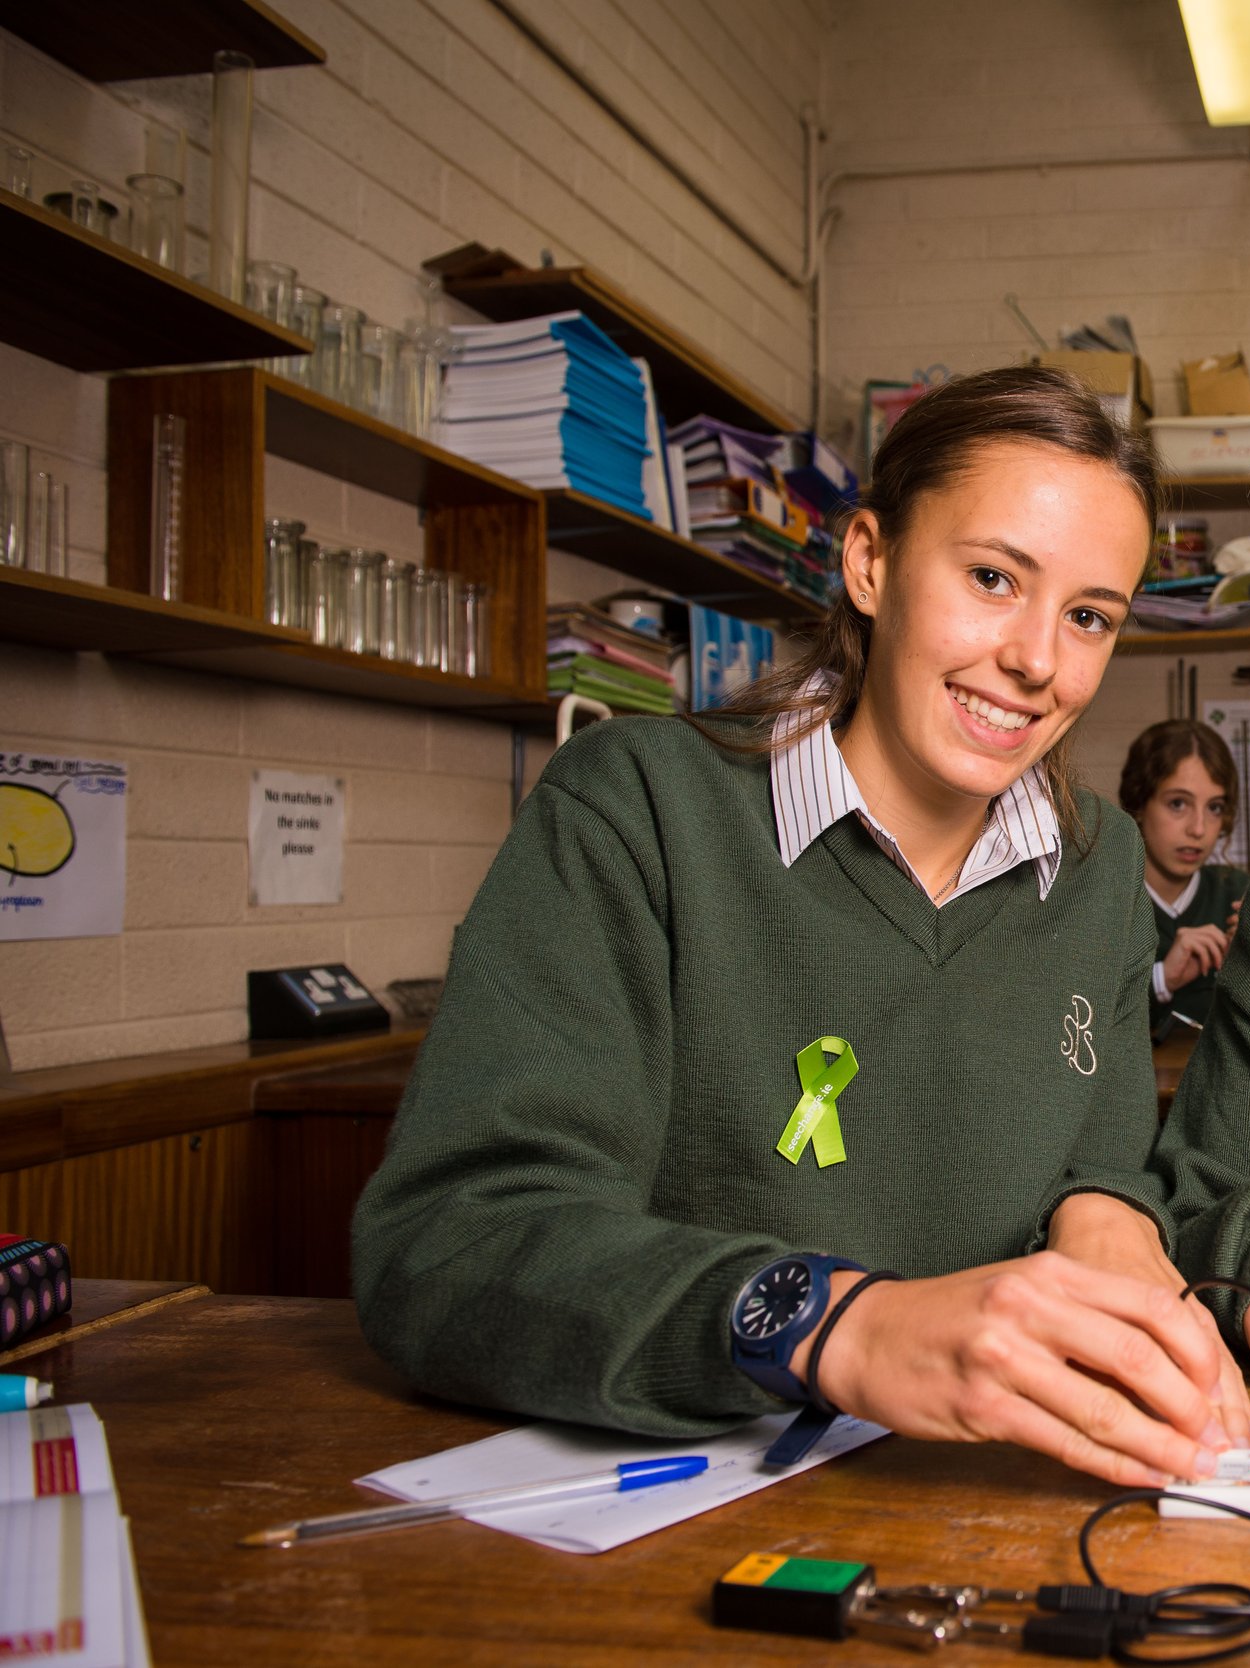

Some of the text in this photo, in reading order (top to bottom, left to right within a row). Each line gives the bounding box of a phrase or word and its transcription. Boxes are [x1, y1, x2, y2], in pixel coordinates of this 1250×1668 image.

[265, 788, 334, 806] No matches in
[277, 816, 320, 831] the sinks
[282, 841, 315, 857] please
[787, 1083, 834, 1153] seechange.ie
